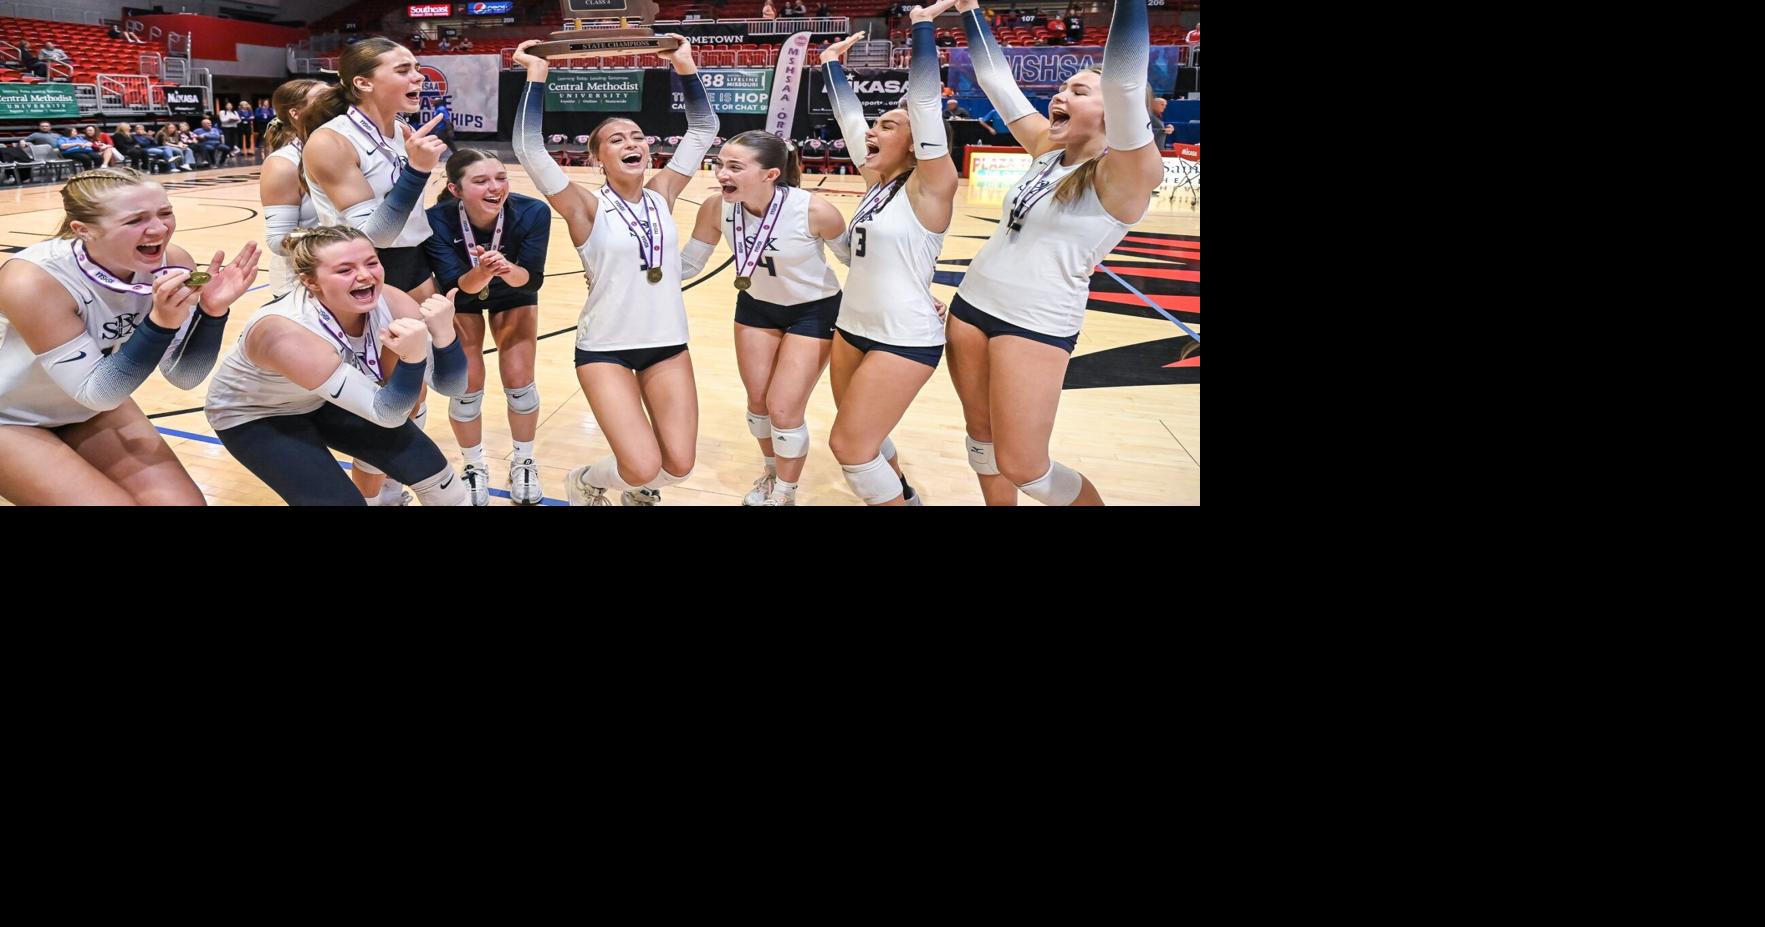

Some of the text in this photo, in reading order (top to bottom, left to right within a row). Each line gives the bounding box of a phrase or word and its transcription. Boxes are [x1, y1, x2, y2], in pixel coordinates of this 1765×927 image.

[410, 6, 449, 14] Southeast
[684, 35, 744, 44] OMETOWN
[1005, 54, 1094, 82] MSHSA
[548, 82, 639, 91] Central Methodist
[0, 94, 74, 102] entral Methodist
[734, 93, 769, 103] HOP
[735, 103, 758, 111] CHAT
[855, 227, 867, 258] 3
